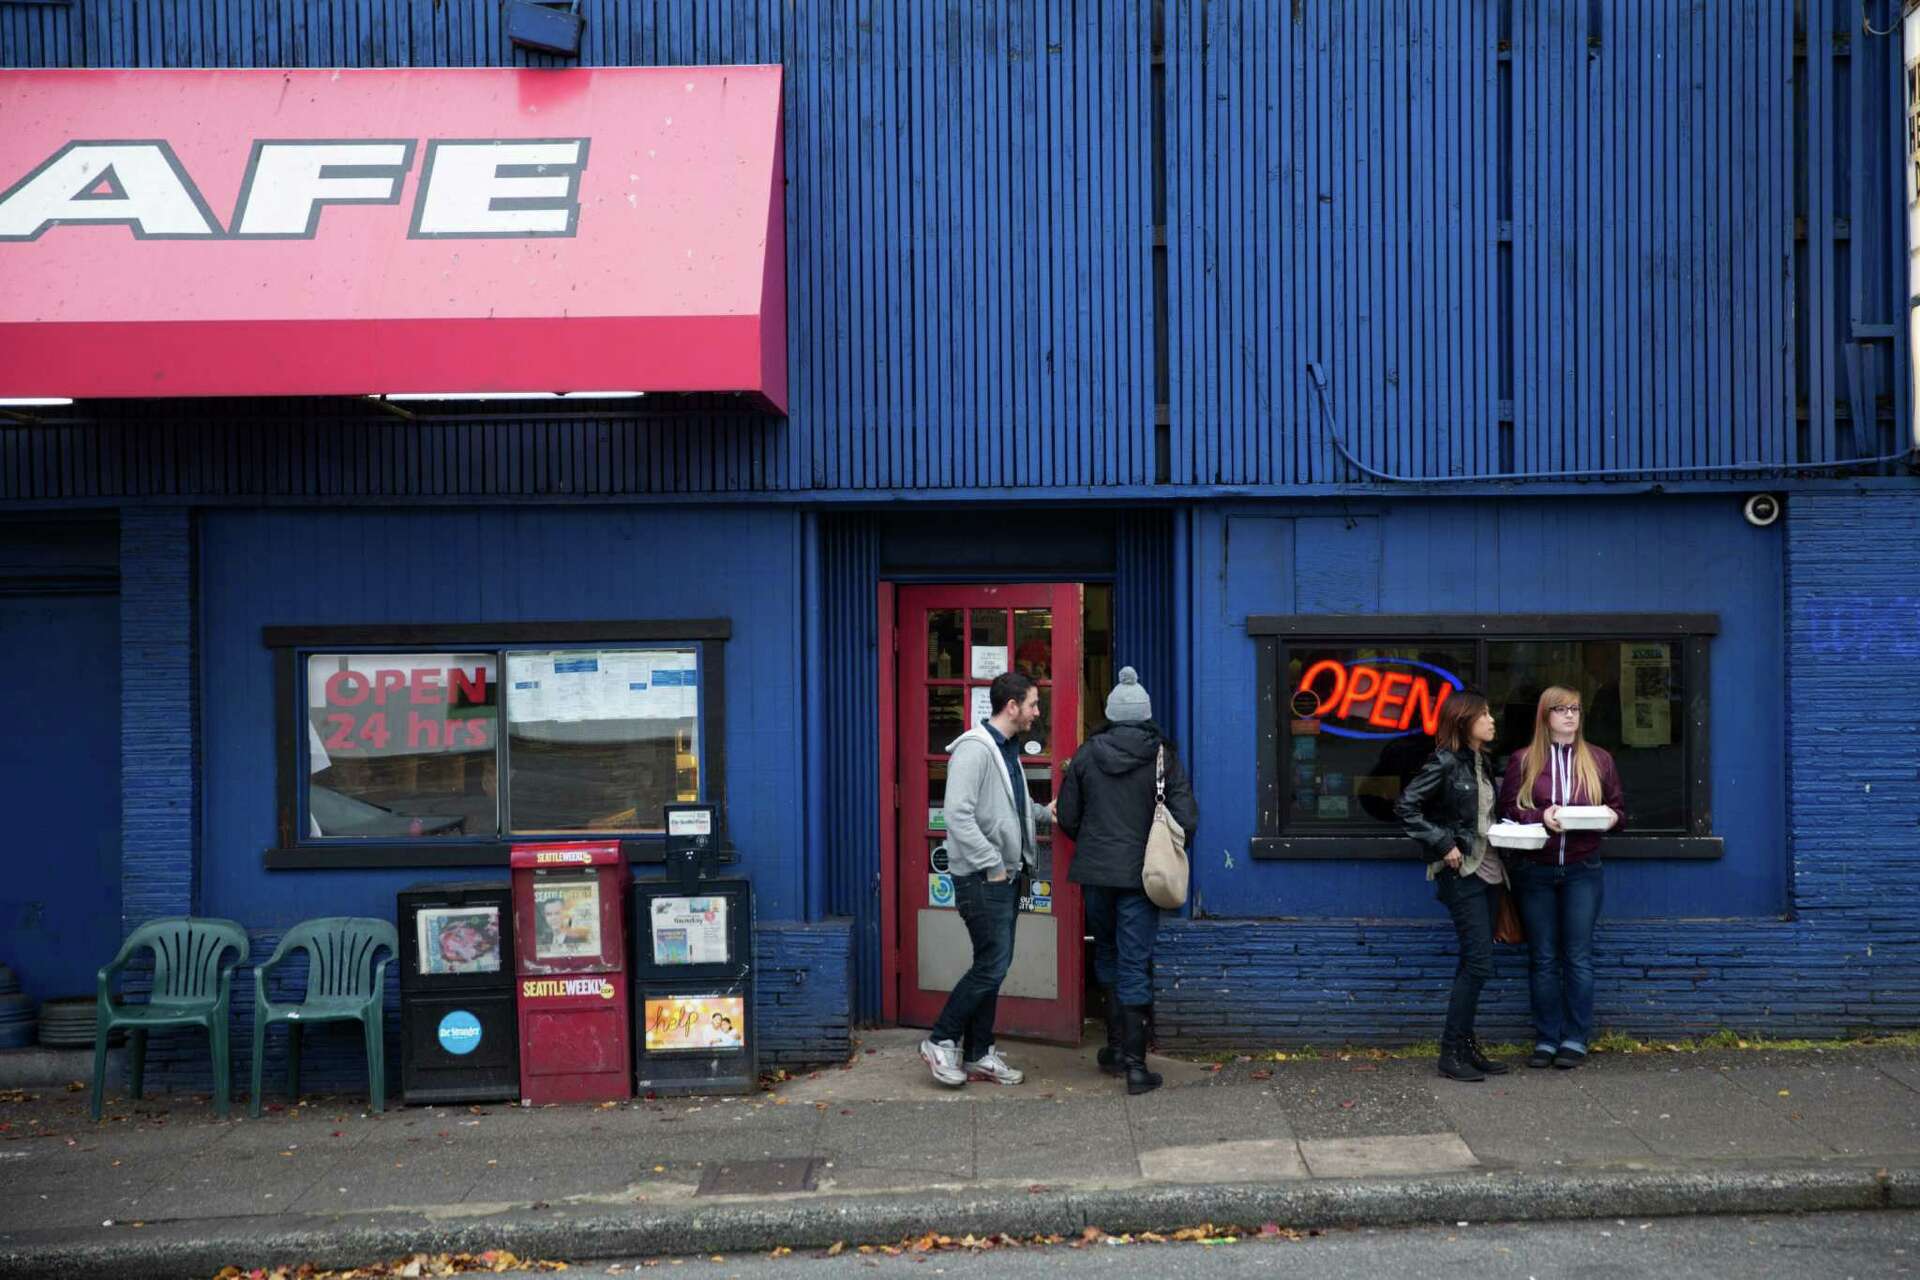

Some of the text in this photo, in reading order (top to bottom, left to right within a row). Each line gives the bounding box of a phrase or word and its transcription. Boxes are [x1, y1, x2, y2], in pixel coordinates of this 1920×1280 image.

[325, 667, 486, 707] OPEN
[1299, 659, 1453, 736] OPEN
[325, 710, 488, 749] 24 hrs
[647, 1005, 699, 1040] help
